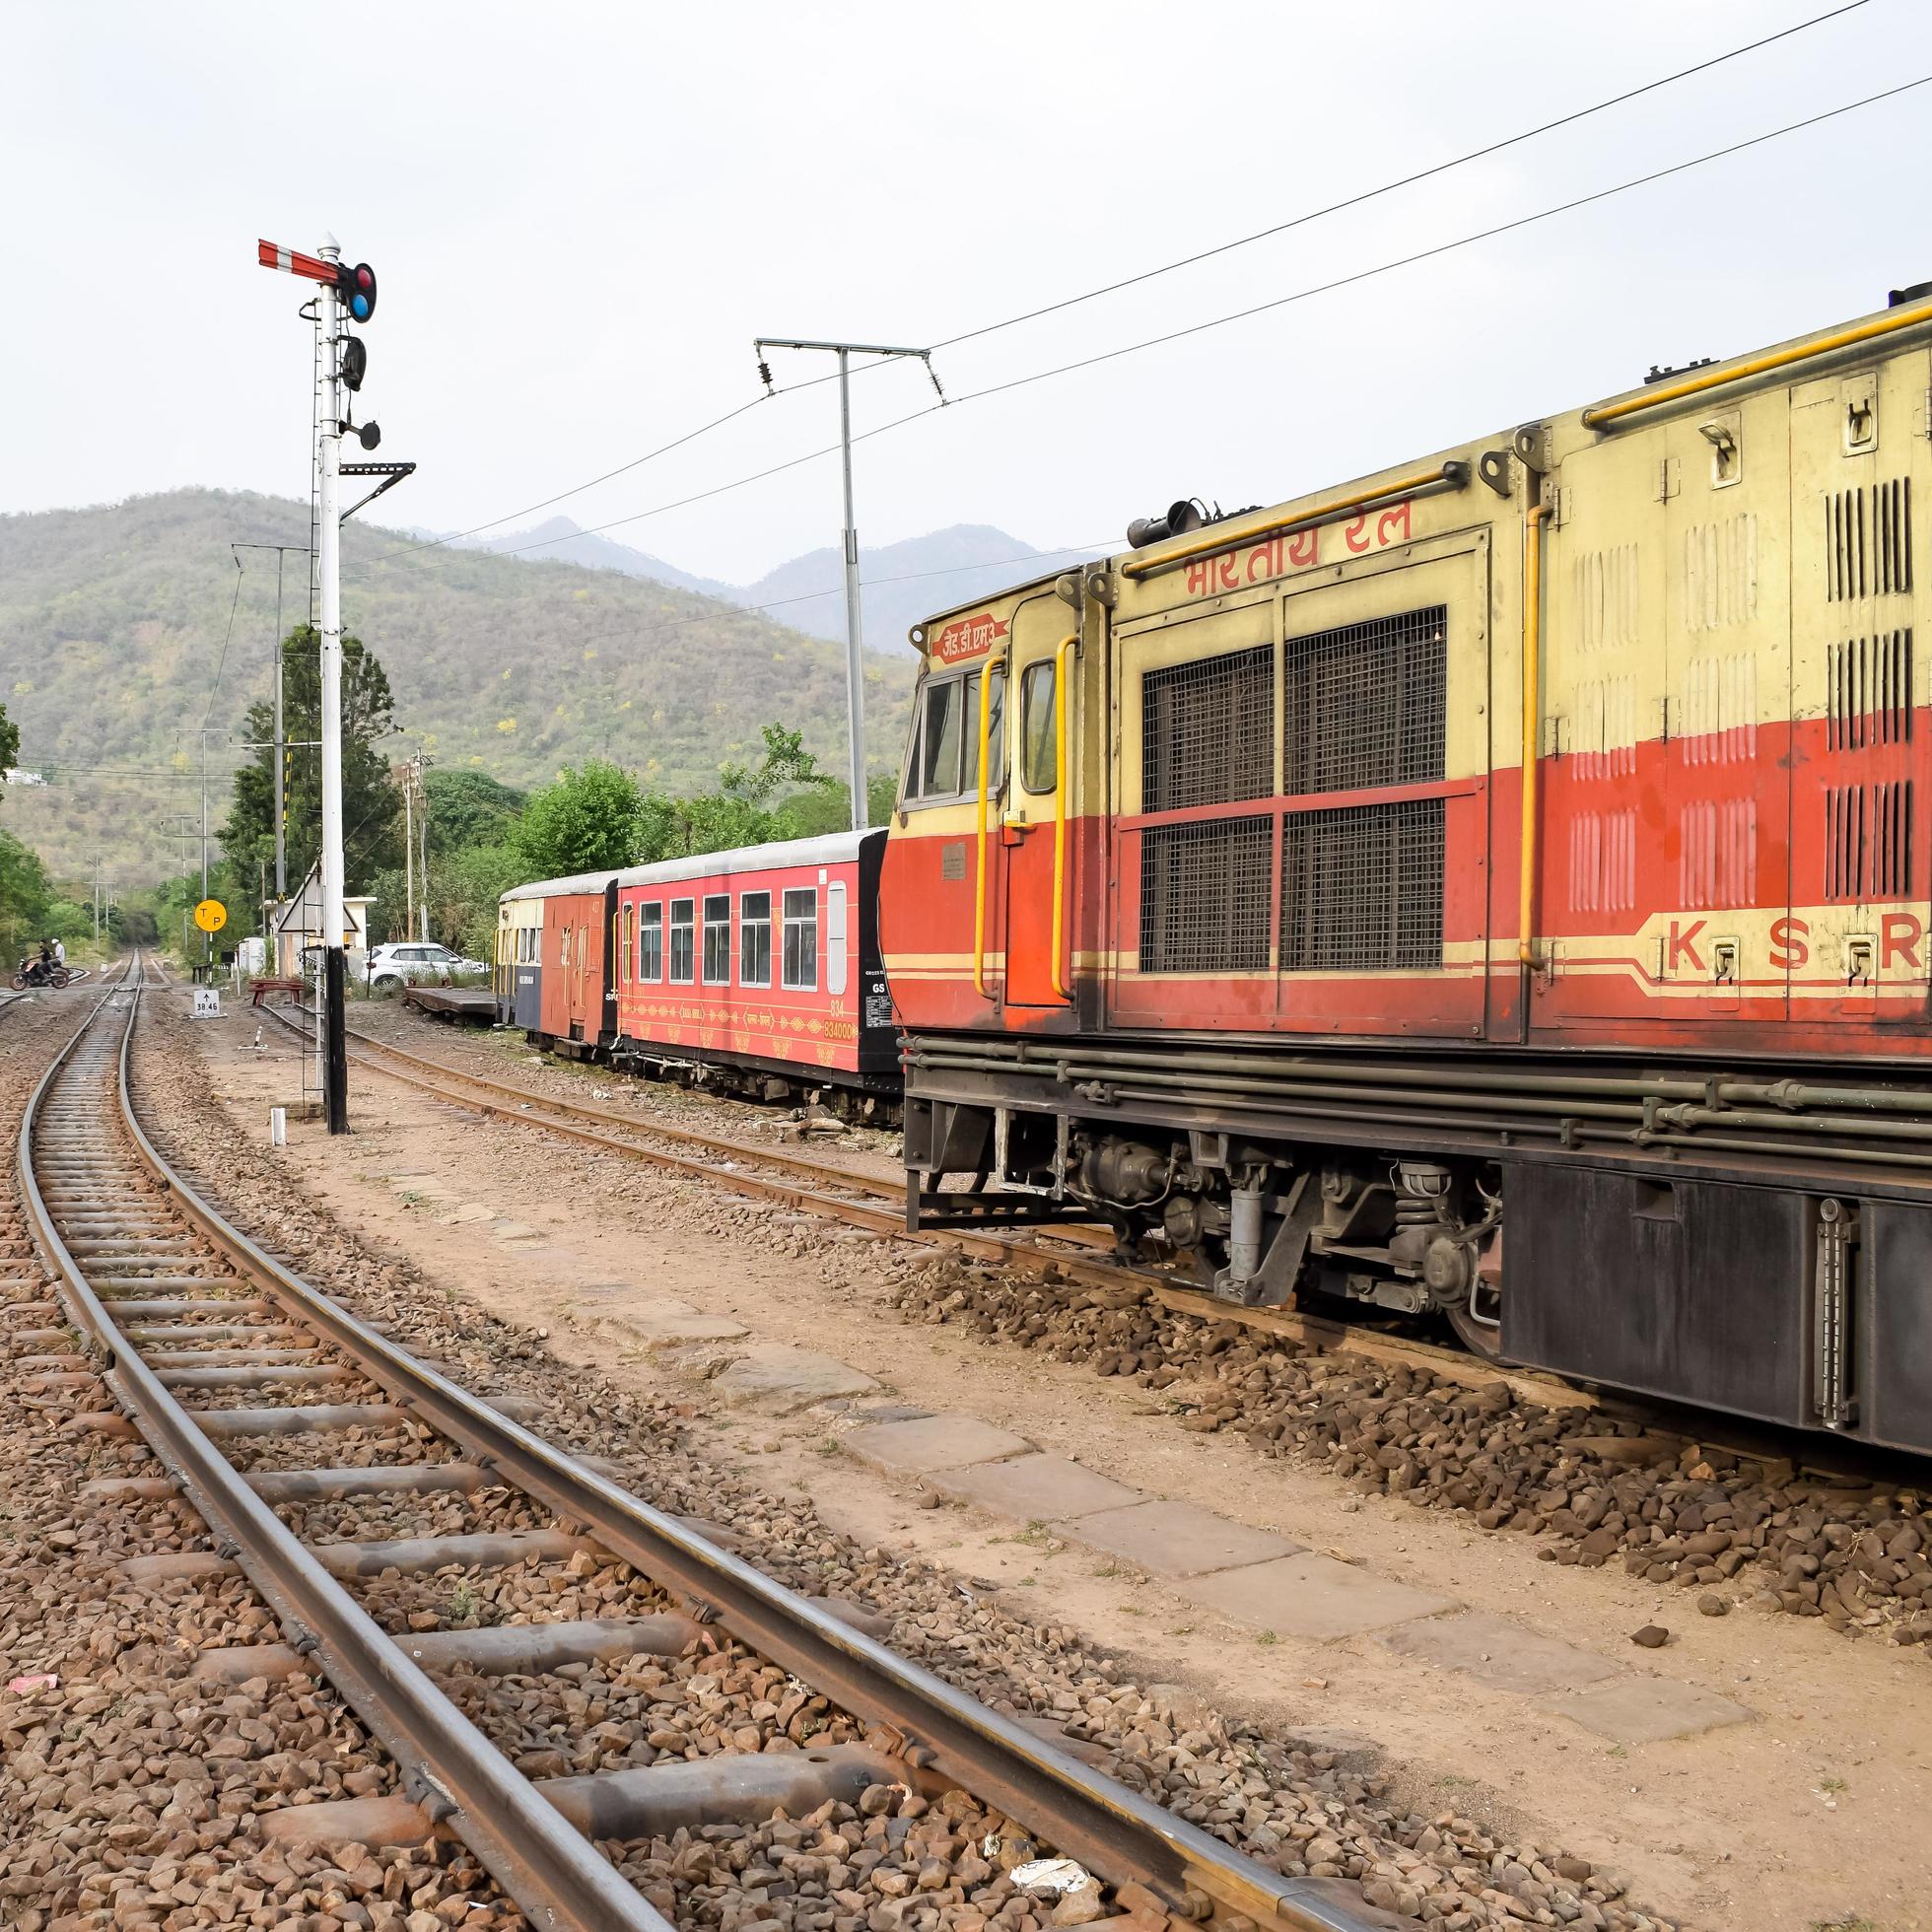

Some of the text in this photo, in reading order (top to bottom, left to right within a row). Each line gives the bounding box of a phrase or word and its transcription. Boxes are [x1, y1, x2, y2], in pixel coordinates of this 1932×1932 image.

[199, 908, 208, 918] T
[213, 917, 221, 927] P
[872, 983, 885, 994] GS
[830, 999, 844, 1017] 834
[824, 1020, 852, 1040] 834000
